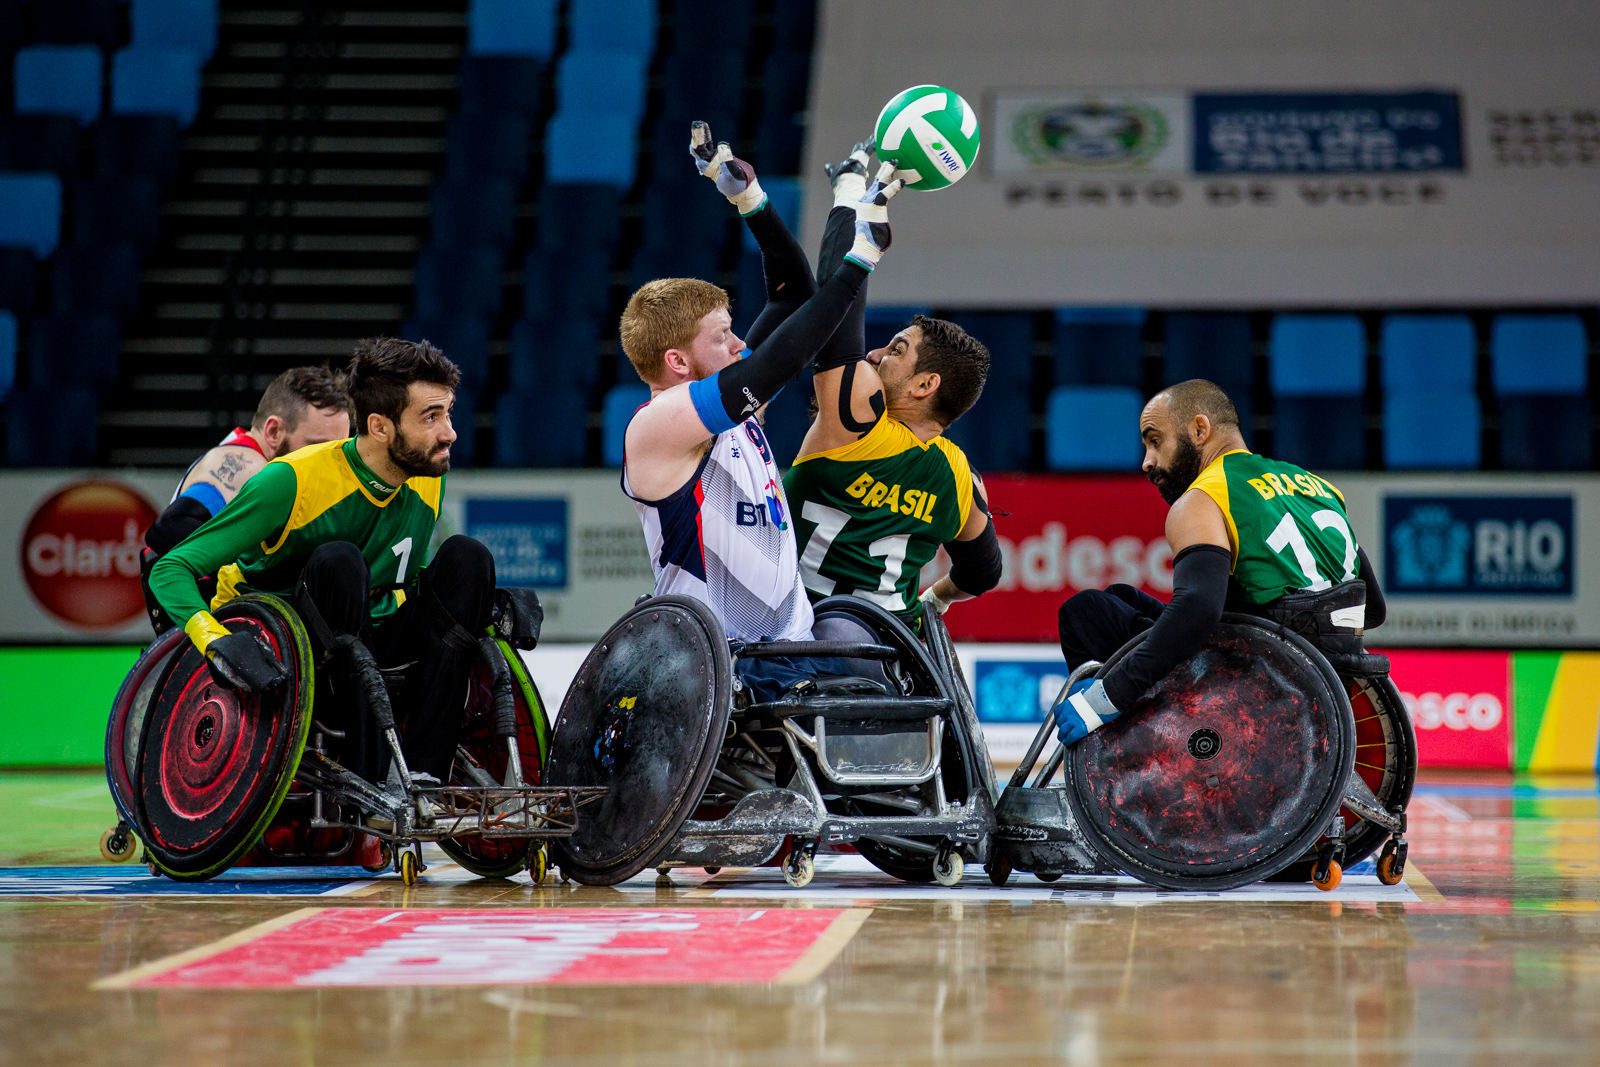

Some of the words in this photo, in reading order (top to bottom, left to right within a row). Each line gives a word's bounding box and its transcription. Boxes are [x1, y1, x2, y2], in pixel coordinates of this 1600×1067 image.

[939, 150, 960, 172] IWRF
[845, 471, 939, 525] BRASIL
[1247, 472, 1333, 501] BRASIL
[28, 522, 143, 578] Claro
[391, 536, 413, 584] 1
[1265, 508, 1359, 593] 12
[1474, 518, 1566, 574] RIO
